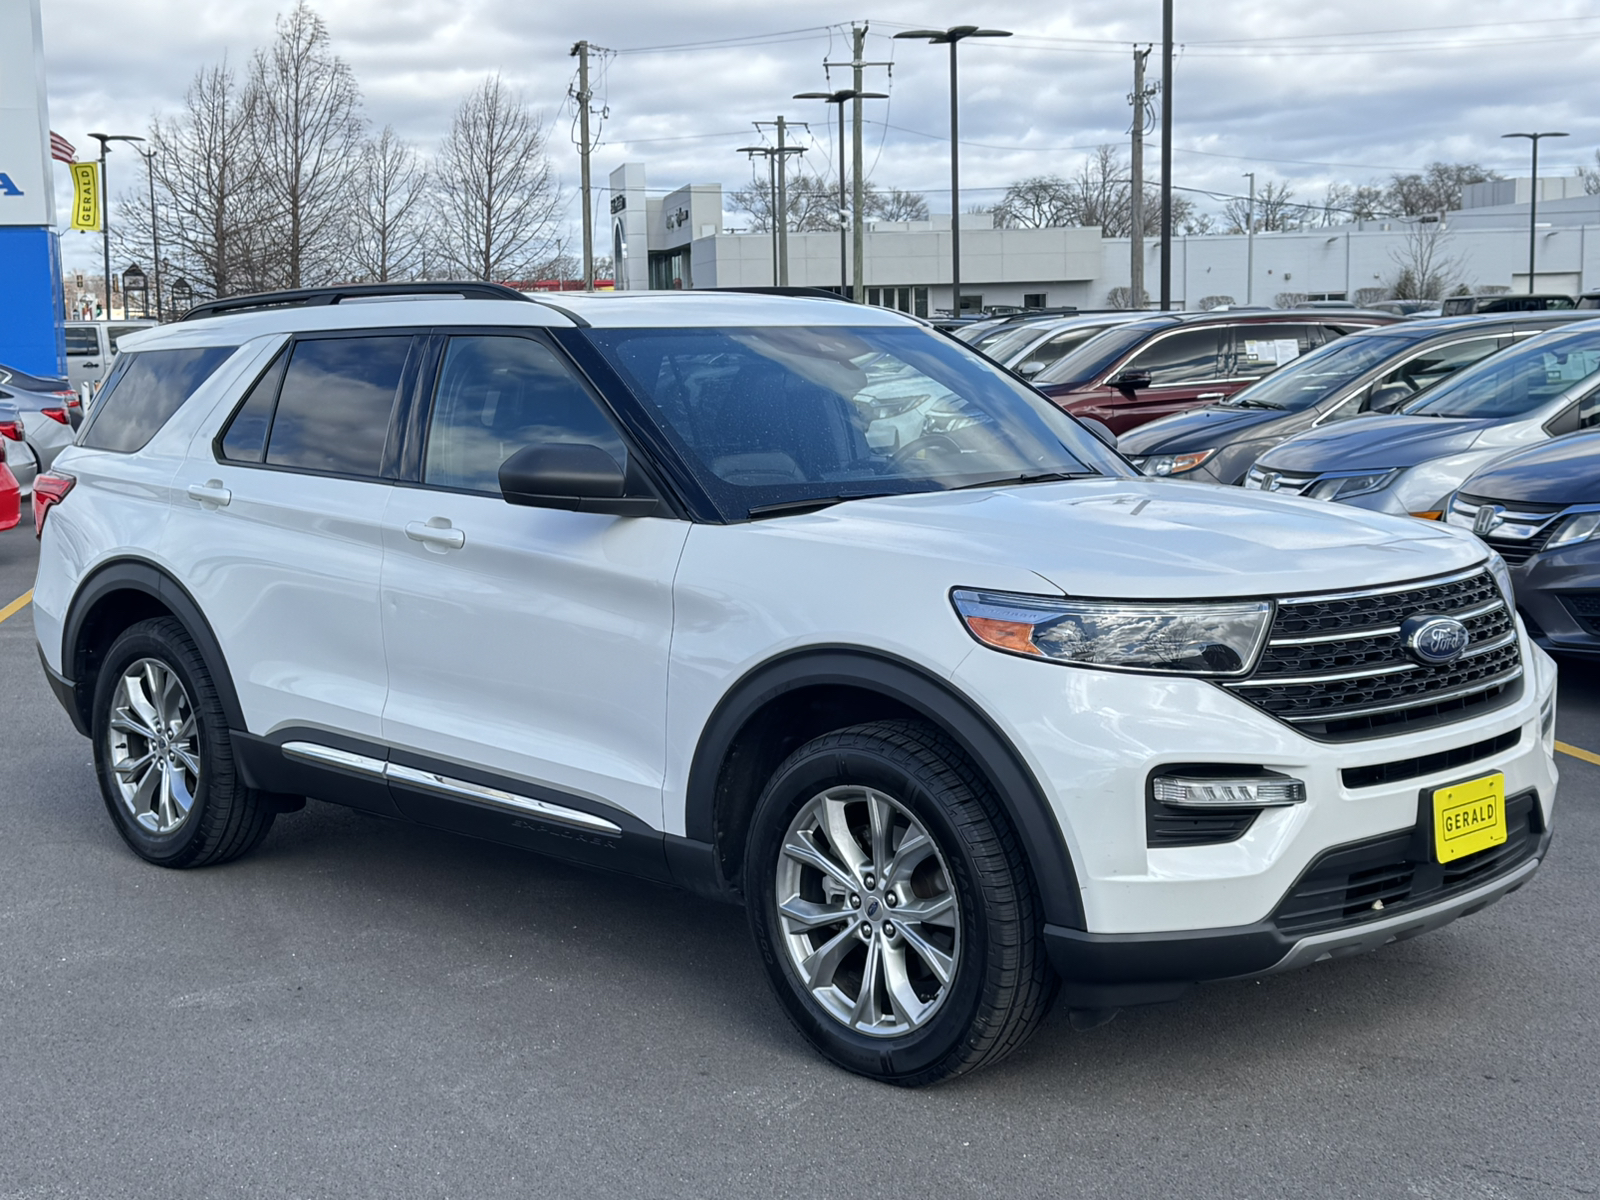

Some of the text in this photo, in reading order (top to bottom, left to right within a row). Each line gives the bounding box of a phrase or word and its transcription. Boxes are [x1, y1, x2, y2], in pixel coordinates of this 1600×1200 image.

[81, 170, 92, 222] GERALD
[1430, 627, 1459, 653] Ford
[1445, 803, 1495, 833] GERALD
